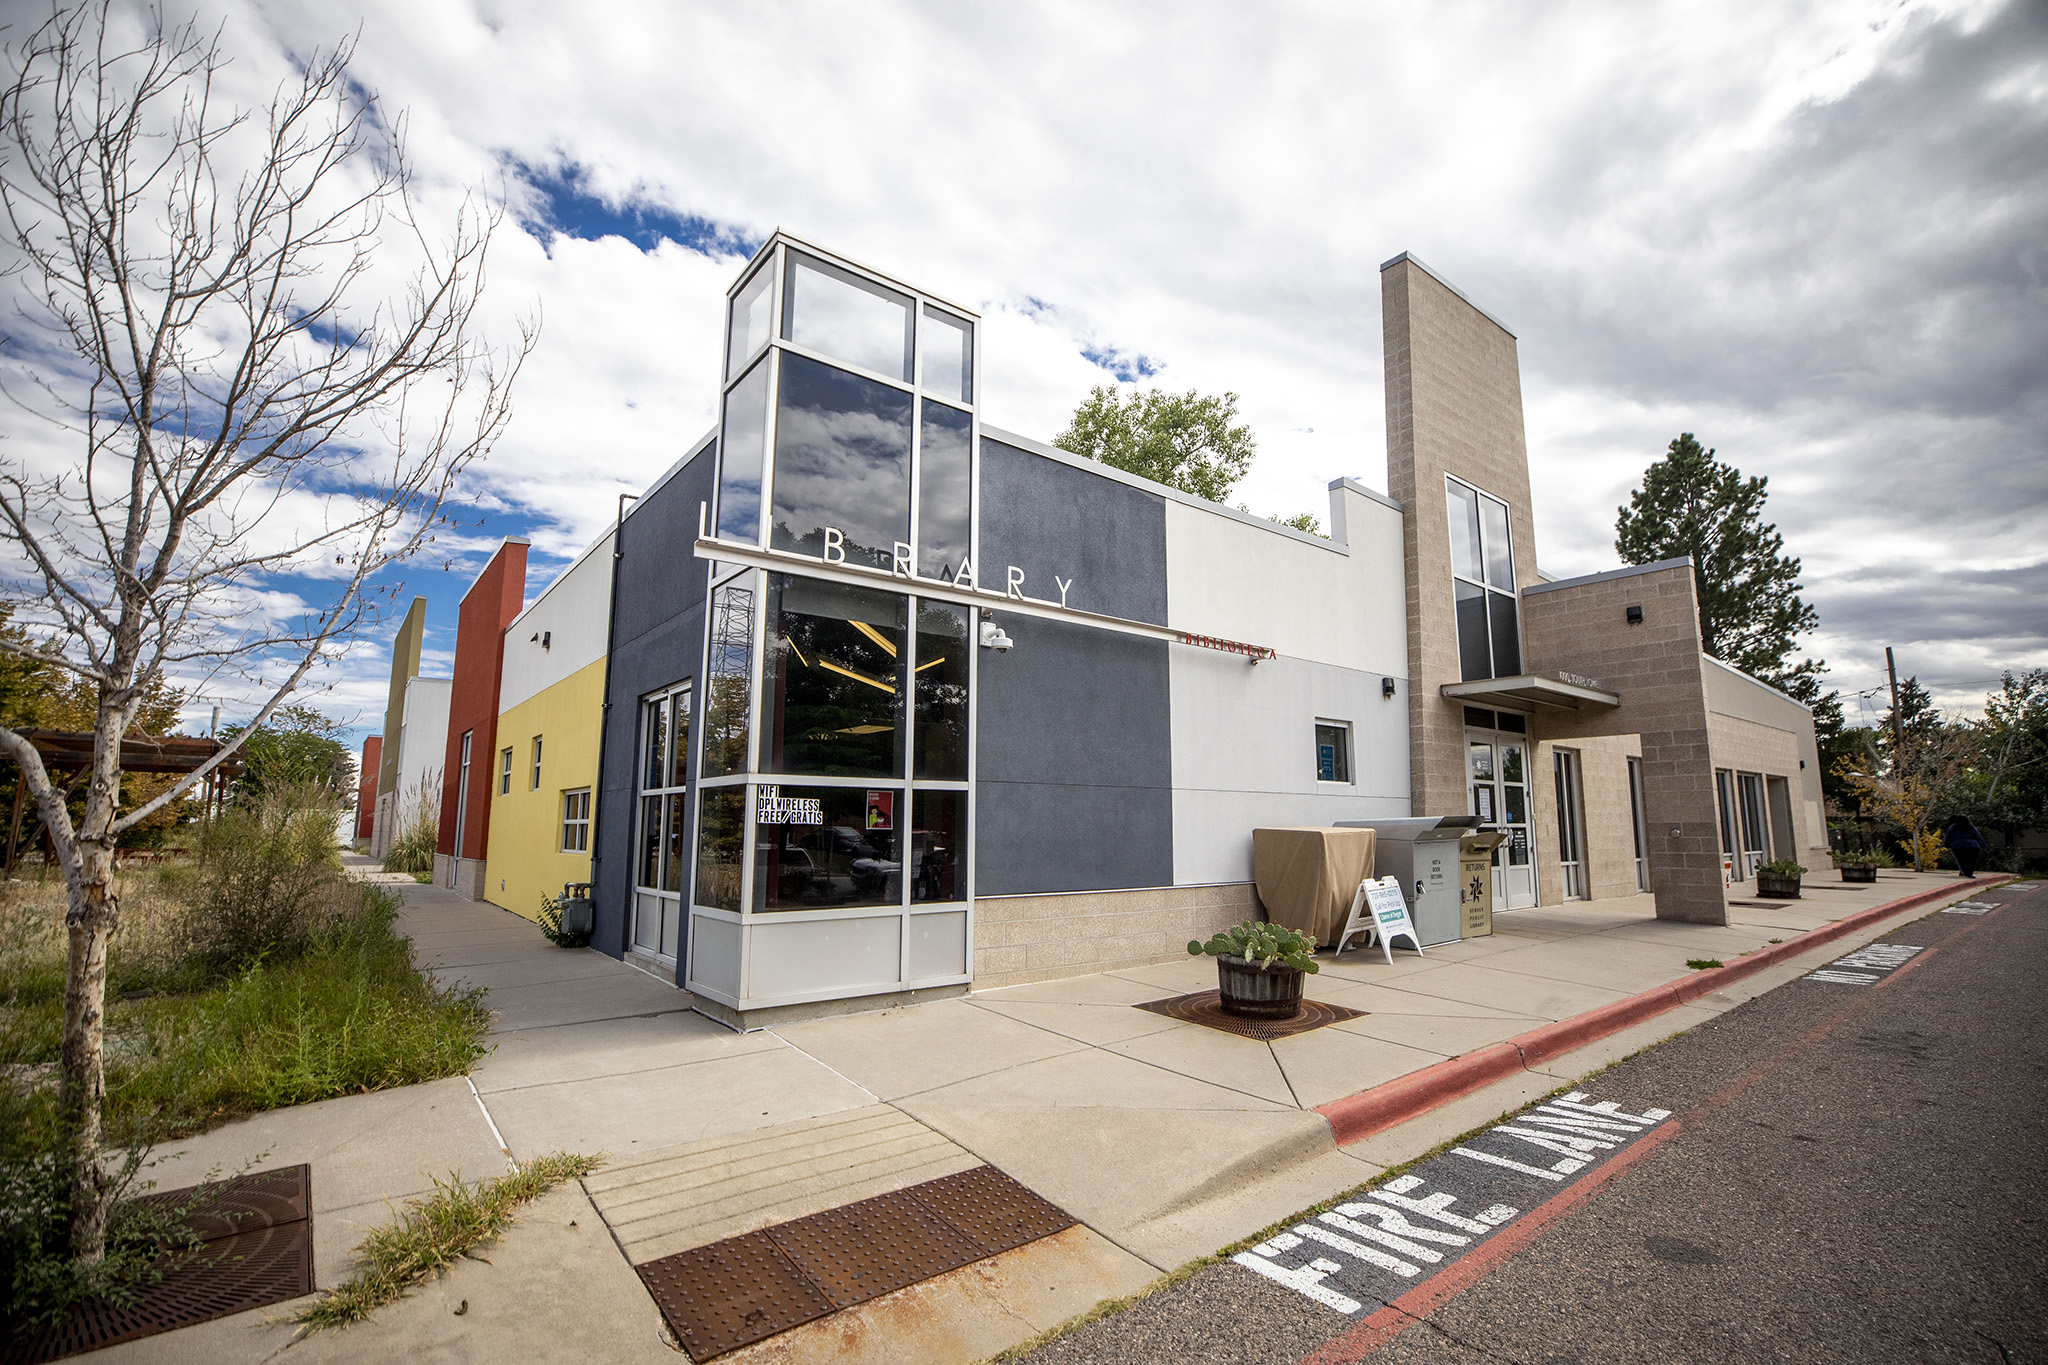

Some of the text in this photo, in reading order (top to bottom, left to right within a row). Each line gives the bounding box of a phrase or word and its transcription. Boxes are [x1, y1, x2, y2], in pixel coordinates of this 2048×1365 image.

[699, 500, 1073, 608] LIBRARY
[1185, 633, 1277, 660] BIBLIOTECA
[759, 785, 779, 798] WIFI
[1465, 863, 1486, 872] RETURNS
[1231, 1091, 1673, 1314] FIRE LANE
